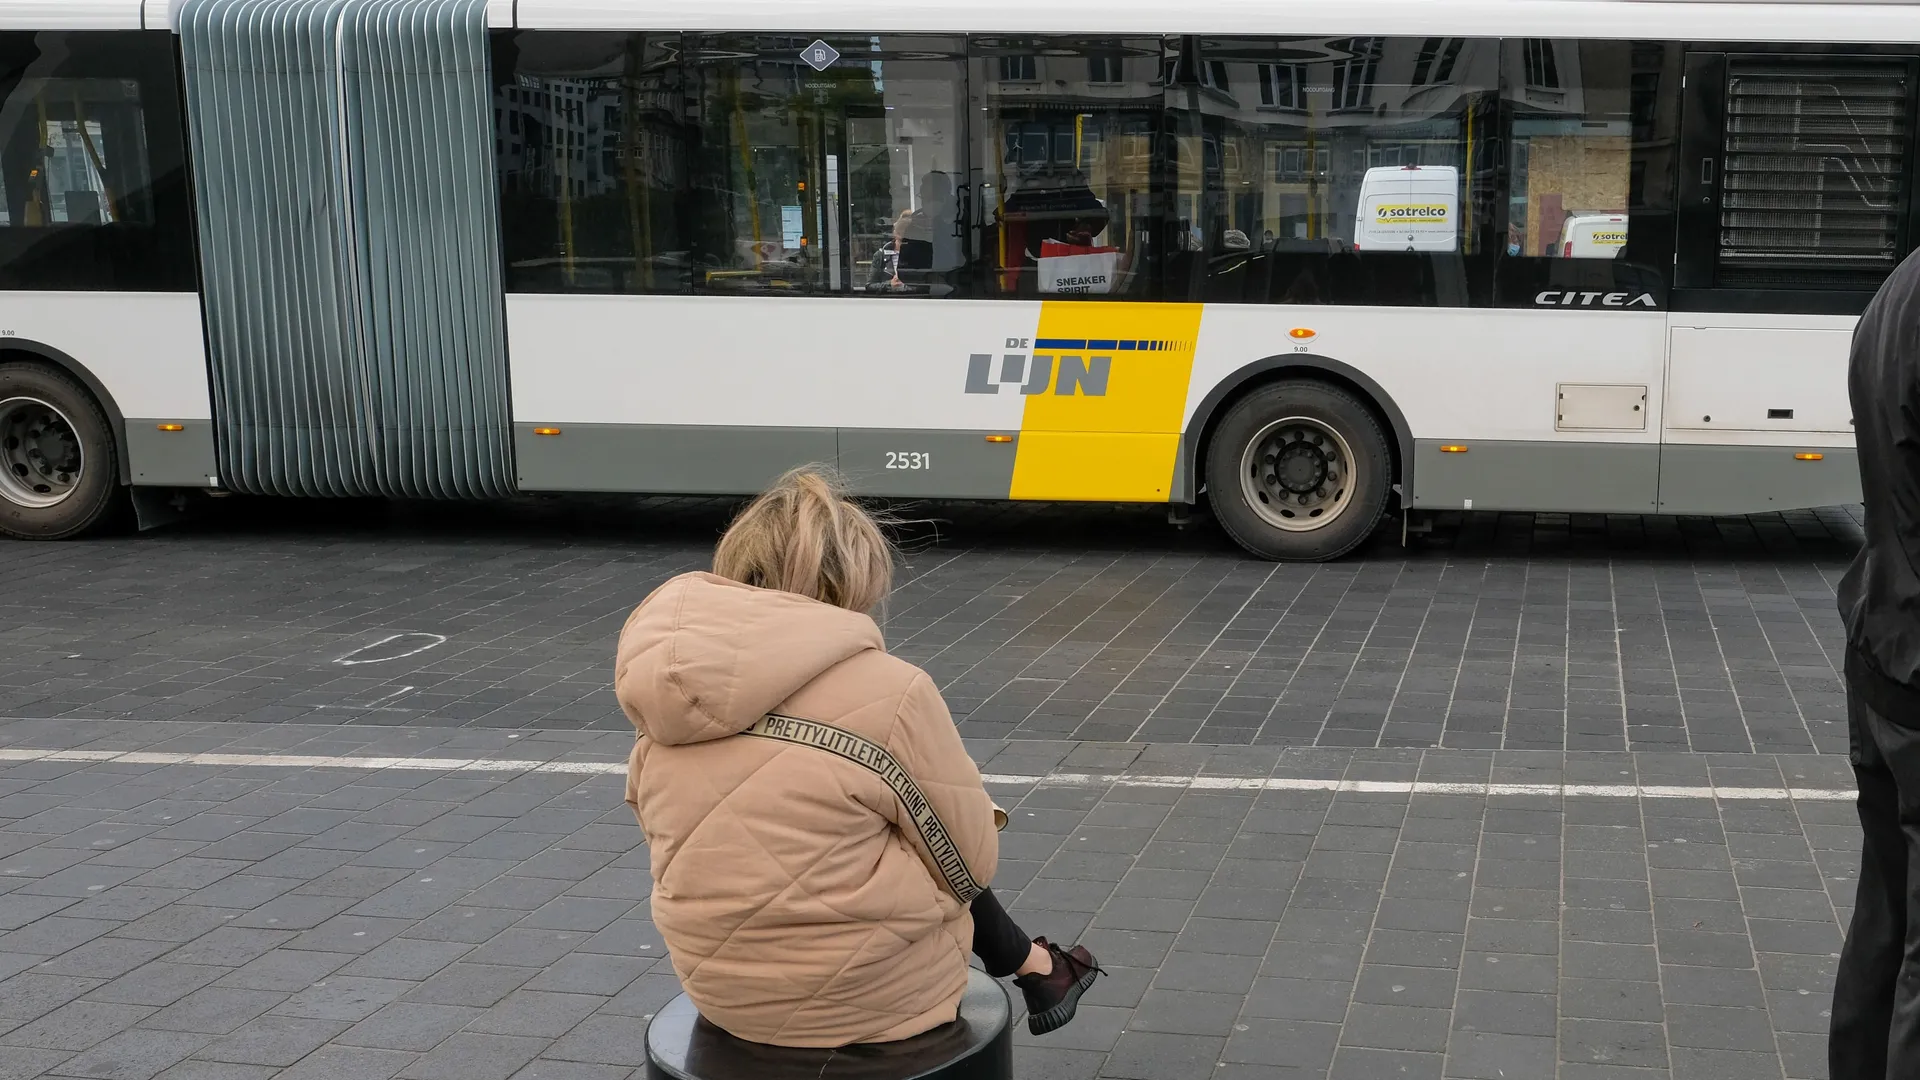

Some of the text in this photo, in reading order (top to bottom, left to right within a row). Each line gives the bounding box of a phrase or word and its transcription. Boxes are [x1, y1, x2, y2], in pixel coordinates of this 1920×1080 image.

[1390, 206, 1446, 217] sotrelco
[1056, 275, 1106, 287] SNEAKER
[1057, 285, 1091, 294] SPIRIT
[1535, 291, 1657, 307] CITEA
[1005, 337, 1029, 349] DE
[885, 451, 930, 470] 2531
